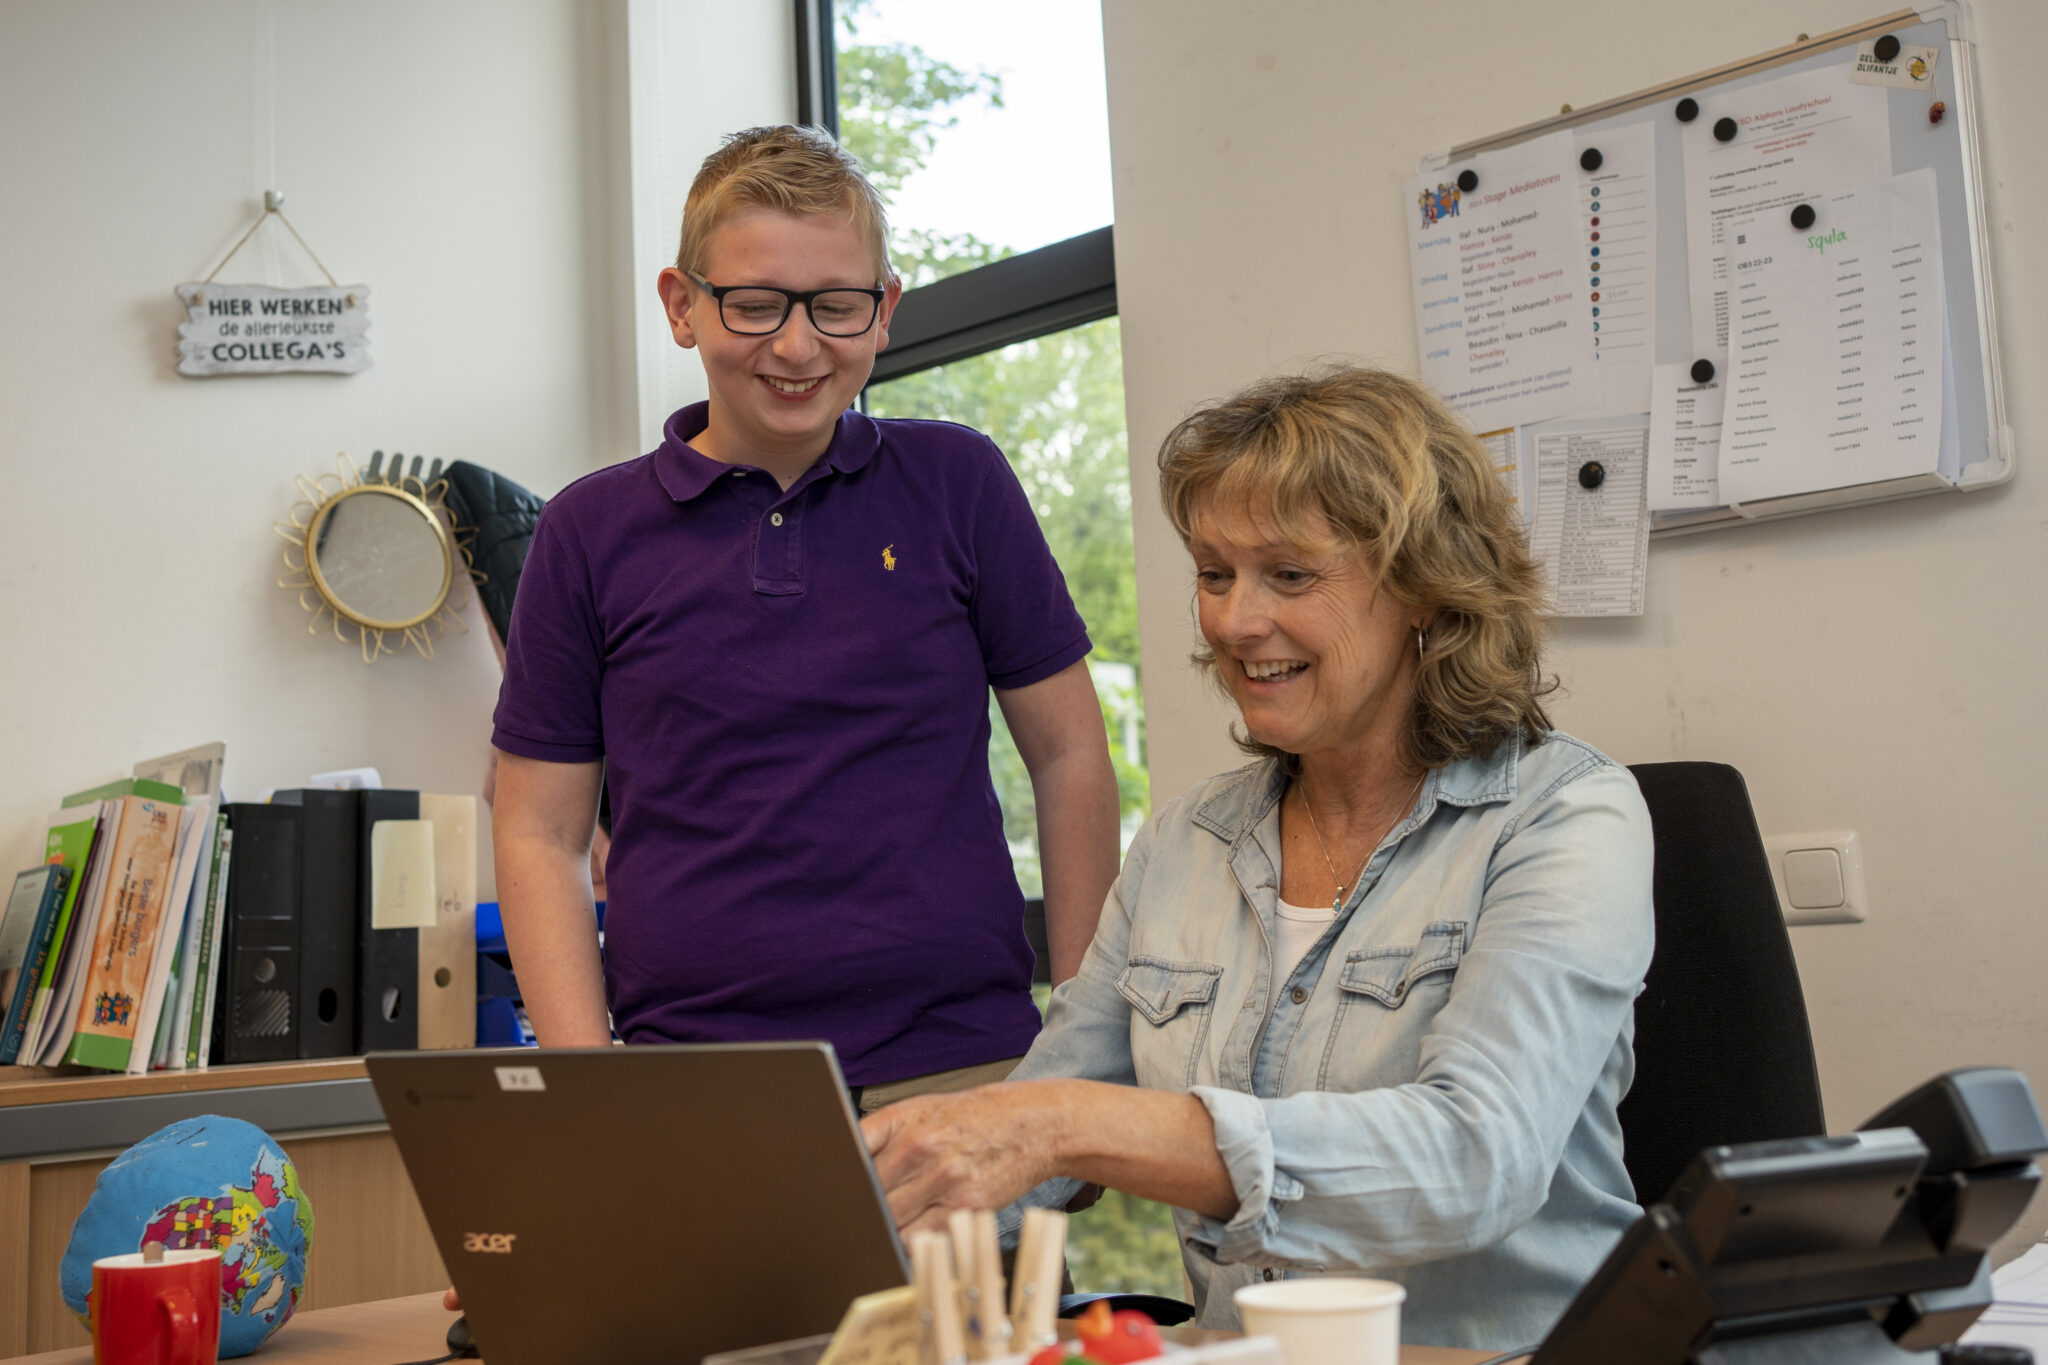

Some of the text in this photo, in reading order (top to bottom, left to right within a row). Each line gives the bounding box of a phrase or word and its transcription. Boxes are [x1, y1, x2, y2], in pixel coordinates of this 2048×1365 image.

[1483, 190, 1507, 206] Stage
[1508, 173, 1561, 197] Mediatoren
[1477, 223, 1495, 235] Nura
[1459, 232, 1513, 252] Hamza Kenzo
[1807, 228, 1848, 255] squla
[1538, 269, 1563, 281] Hamza
[209, 299, 342, 316] HIER WERKEN
[1554, 292, 1573, 304] Stine
[219, 321, 335, 336] de allerleukste
[1468, 336, 1500, 350] Beaudin
[1505, 330, 1523, 342] Nina
[212, 342, 345, 361] COLLEGA'S
[128, 913, 148, 958] burgers
[463, 1233, 517, 1254] acer
